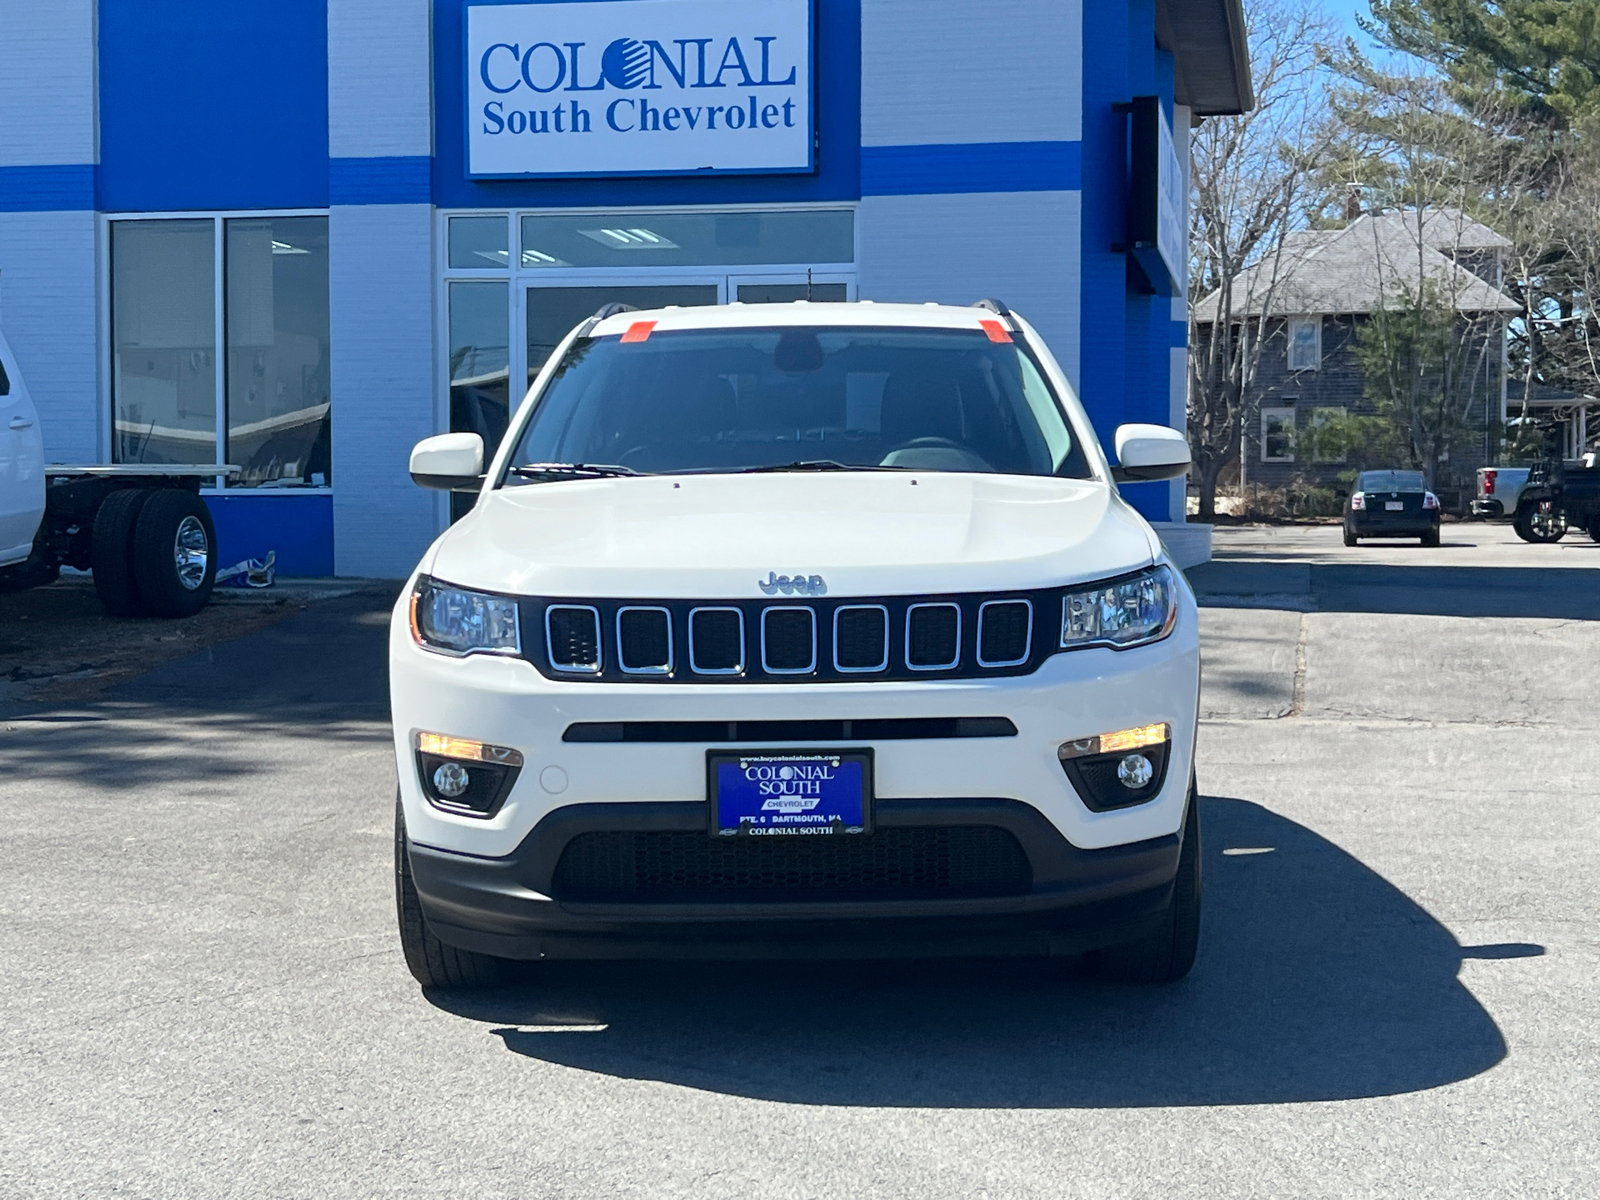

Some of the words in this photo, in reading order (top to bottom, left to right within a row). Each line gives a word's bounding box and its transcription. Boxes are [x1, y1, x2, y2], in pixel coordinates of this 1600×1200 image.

[480, 37, 797, 94] COLONIAL
[483, 100, 592, 135] South
[606, 95, 797, 133] Chevrolet
[758, 571, 828, 597] Jeep
[745, 765, 835, 781] COLONIAL
[759, 781, 821, 795] SOUTH
[767, 800, 814, 808] CHEVROLET
[749, 827, 799, 835] COLONIAL
[800, 826, 833, 834] SOUTH
